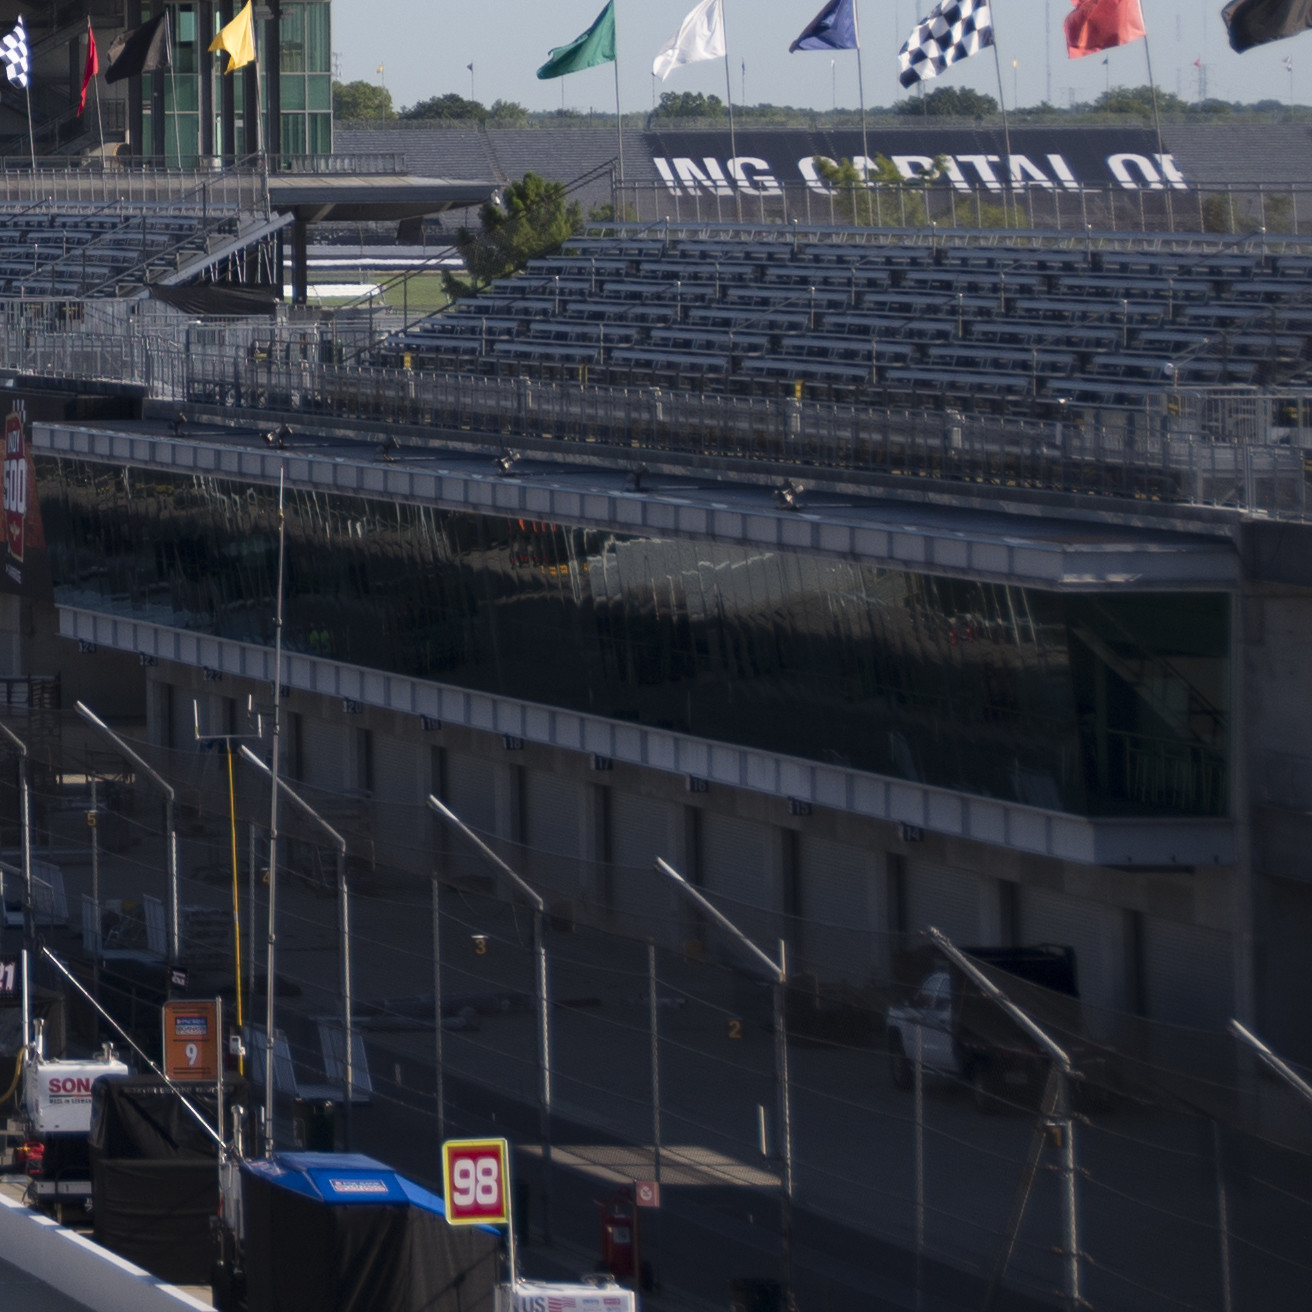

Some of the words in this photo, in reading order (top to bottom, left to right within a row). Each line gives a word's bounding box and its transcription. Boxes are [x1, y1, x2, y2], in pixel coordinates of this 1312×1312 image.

[3, 458, 26, 515] 500
[185, 1043, 198, 1067] 9
[453, 1158, 498, 1206] 98
